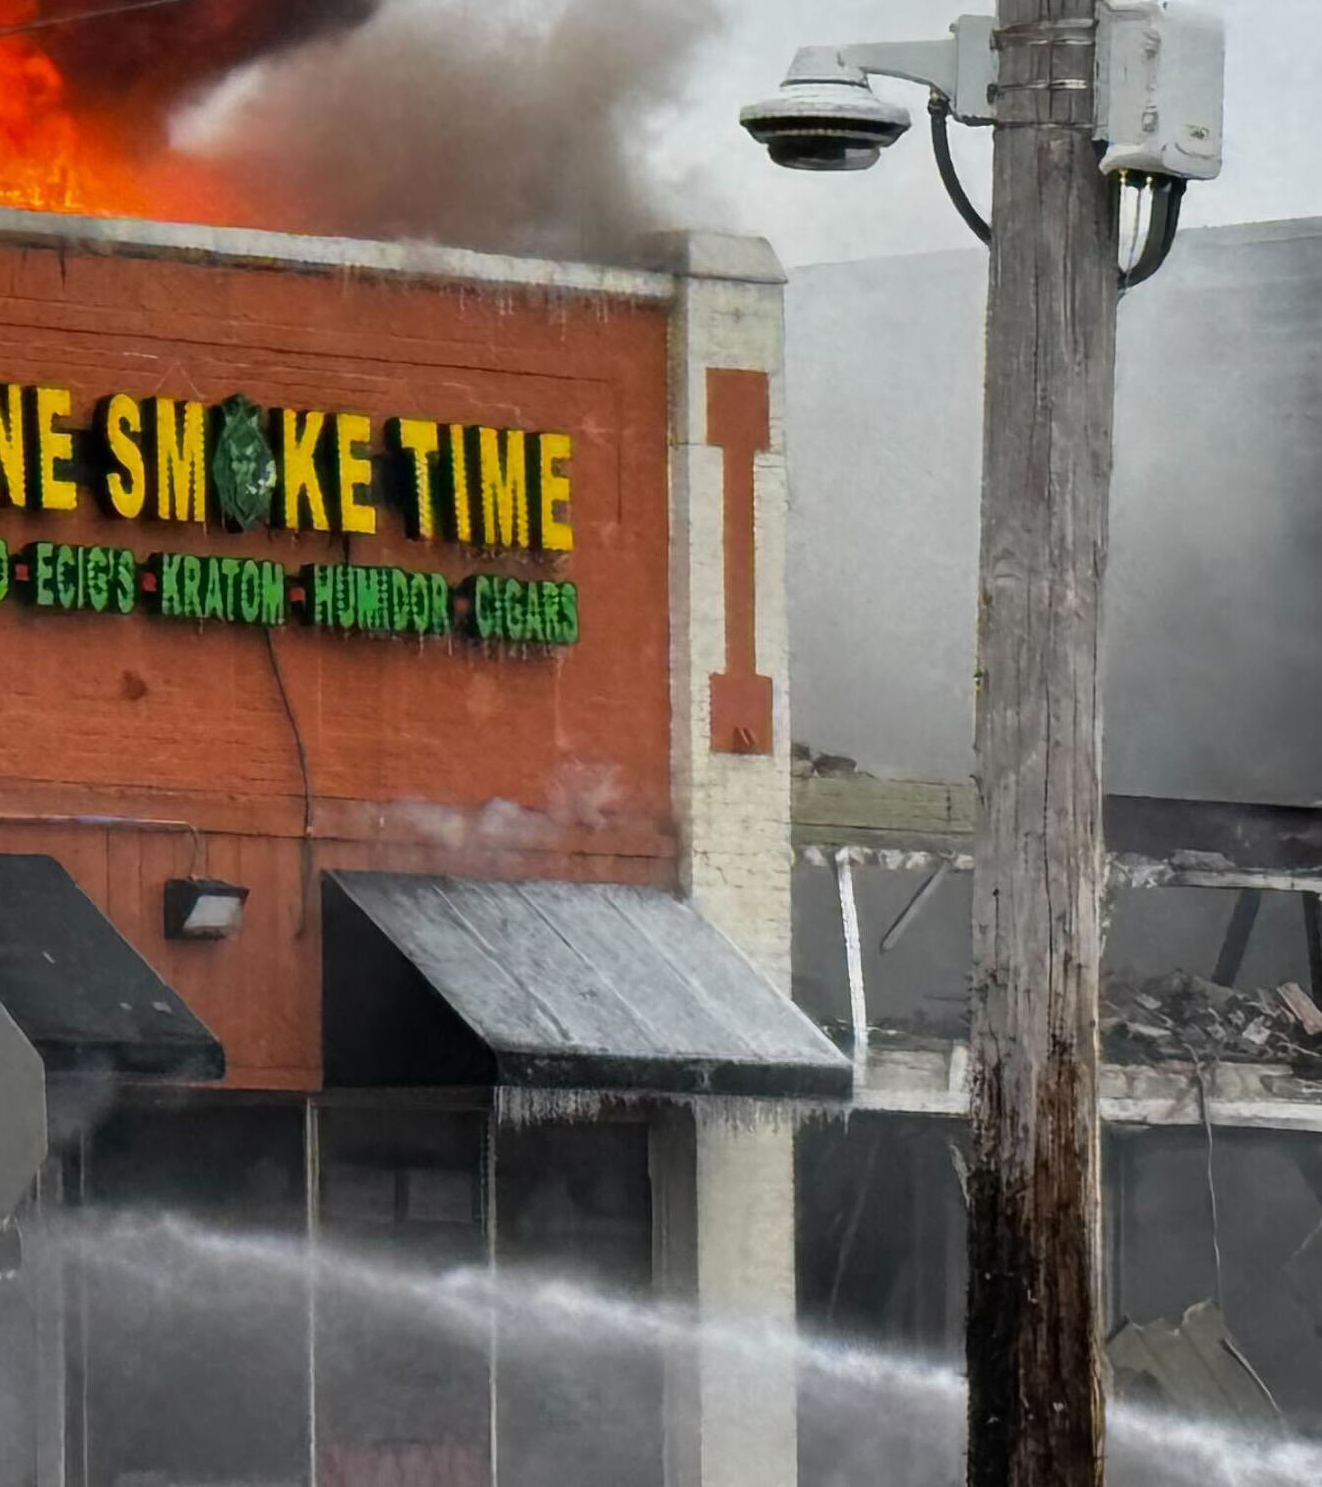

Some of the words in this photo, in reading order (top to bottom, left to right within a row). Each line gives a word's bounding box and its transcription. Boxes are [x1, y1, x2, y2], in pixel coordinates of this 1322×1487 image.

[397, 417, 574, 552] TIME
[161, 553, 285, 626] KRATOM
[313, 563, 450, 634] HUMIDOR
[474, 574, 579, 644] CIGARS
